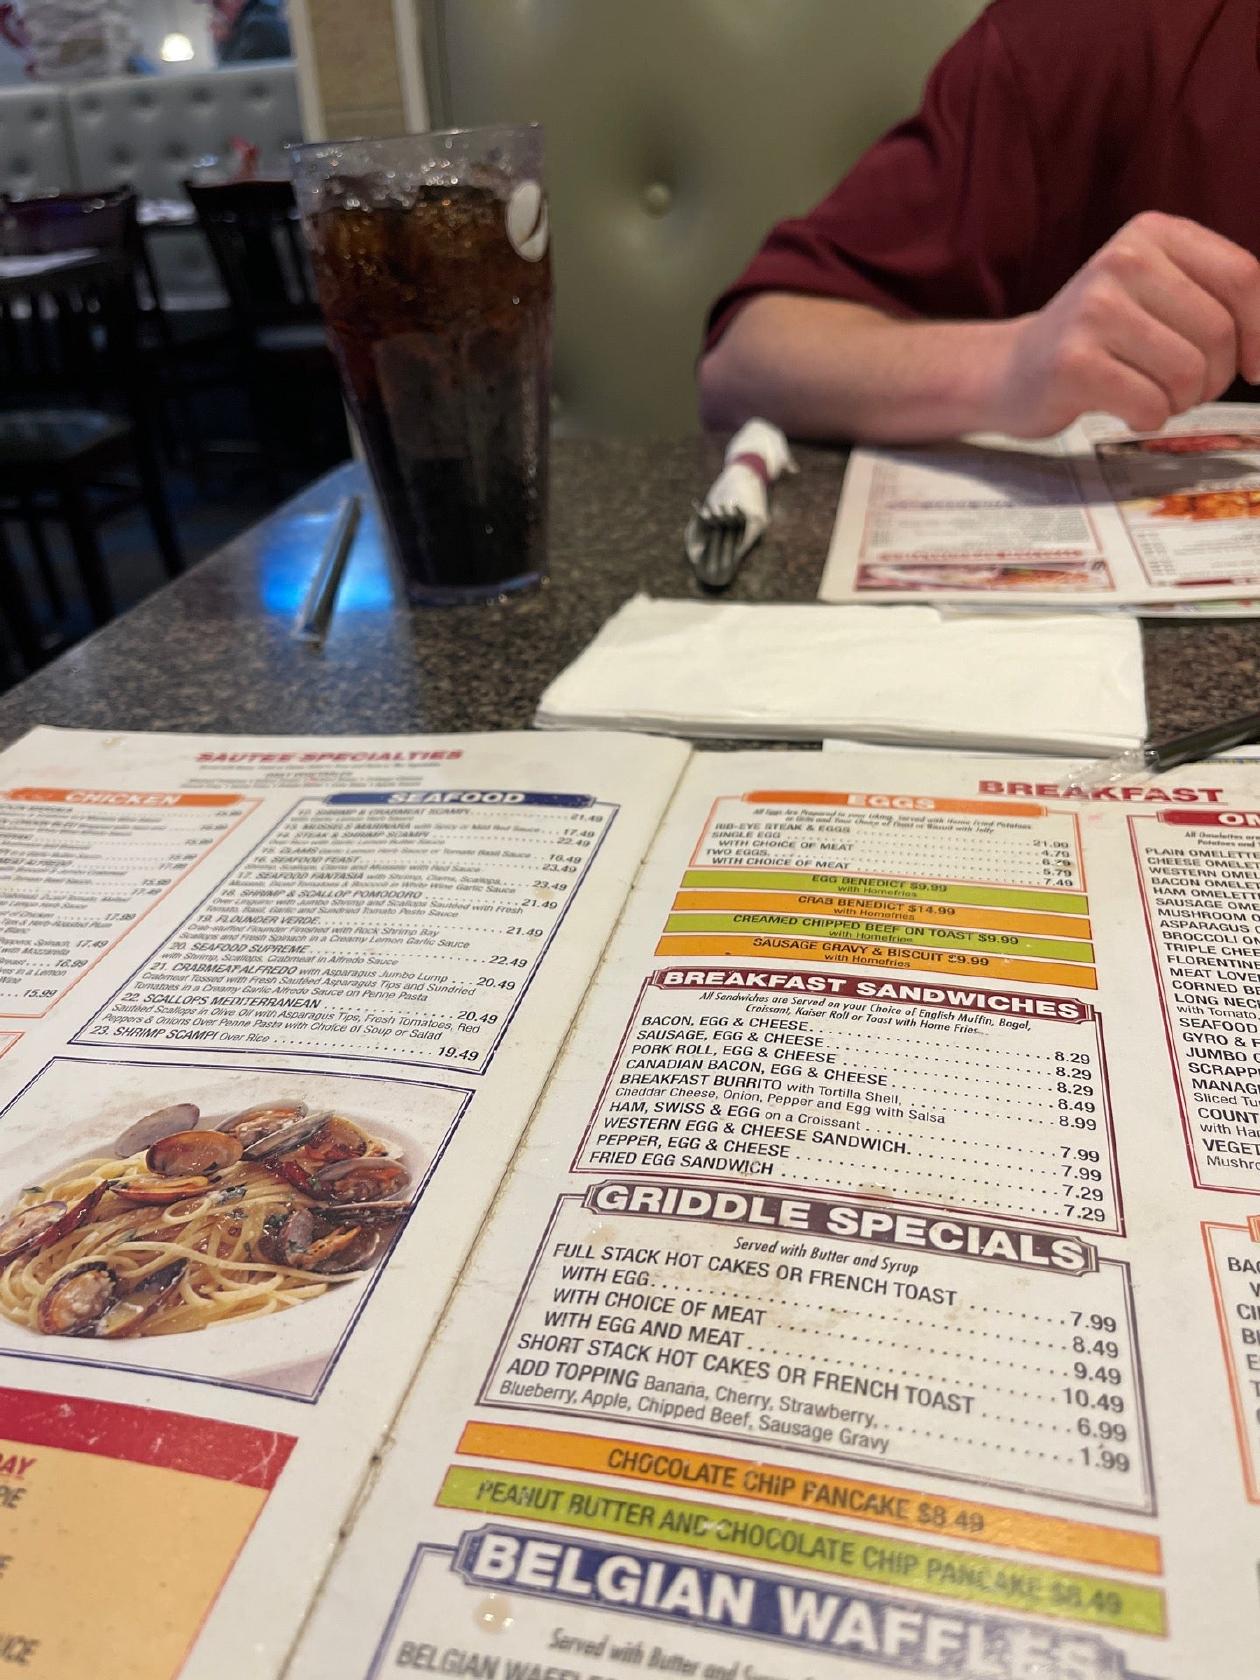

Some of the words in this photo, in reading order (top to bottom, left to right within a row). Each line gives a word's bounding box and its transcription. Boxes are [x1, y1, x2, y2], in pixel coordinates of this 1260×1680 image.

[299, 750, 464, 762] SPECIALTIES
[65, 793, 181, 805] CHICKEN
[388, 792, 525, 805] SEAFOOD
[978, 780, 1224, 802] BREAKFAST
[848, 794, 936, 811] EGGS
[746, 858, 792, 866] CHOICE
[816, 861, 850, 869] MEAT
[1044, 878, 1073, 887] 7.49
[1043, 869, 1072, 877] 5.79
[1149, 867, 1217, 878] WESTERN
[1151, 877, 1200, 887] BACON
[1153, 887, 1186, 896] HAM
[798, 895, 833, 905] CRAB
[838, 898, 906, 911] BENEDICT
[908, 905, 956, 915] $14.99
[1156, 898, 1224, 909] SAUSAGE
[1158, 908, 1247, 922] MUSHROOM
[506, 926, 544, 938] 21.49
[733, 914, 798, 925] CREAMED
[802, 918, 861, 930] CHIPPED
[865, 924, 900, 934] BEEF
[905, 926, 924, 936] ON
[930, 929, 974, 940] TOAST
[978, 934, 1019, 945] $9.99
[1160, 920, 1250, 933] ASPARAGUS
[1162, 931, 1238, 944] BROCCOLI
[1164, 942, 1217, 954] TRIPLE
[190, 942, 248, 952] SEAFOOD
[248, 944, 310, 953] SUPREME
[488, 955, 528, 968] 22.49
[752, 938, 818, 950] SAUSAGE
[822, 943, 868, 953] GRAVY
[872, 948, 882, 956] &
[888, 949, 943, 961] BISCUIT
[54, 959, 89, 968] 16.99
[824, 954, 849, 962] with
[852, 955, 911, 968] Homefries
[172, 963, 241, 974] CRABMEAT
[240, 965, 298, 975] ALFREDO
[476, 977, 516, 990] 20.49
[1169, 968, 1212, 979] MEAT
[23, 989, 57, 998] 15.99
[663, 971, 847, 993] BREAKFAST
[856, 980, 1080, 1019] SANDWICHES
[1172, 980, 1238, 994] CORNED
[143, 994, 208, 1005] SCALLOPS
[210, 997, 322, 1009] MEDITERRANEAN
[457, 1011, 499, 1025] 20.49
[1174, 993, 1219, 1006] LONG
[1179, 1018, 1258, 1034] SEAFOOD
[89, 1025, 110, 1035] 23.
[113, 1027, 166, 1038] SHRIMP
[165, 1029, 220, 1041] SCAMPI
[219, 1032, 245, 1042] Over
[245, 1034, 270, 1043] Rice
[438, 1046, 480, 1061] 19.49
[641, 1016, 695, 1027] BACON,
[699, 1016, 729, 1027] EGG
[732, 1018, 744, 1027] &
[749, 1018, 809, 1032] CHEESE
[1054, 1051, 1091, 1065] 8.29
[1182, 1032, 1229, 1046] GYRO
[1234, 1037, 1247, 1048] &
[1185, 1047, 1247, 1062] JUMBO
[631, 1044, 673, 1055] PORK
[676, 1045, 718, 1056] ROLL,
[722, 1046, 753, 1056] EGG
[757, 1047, 769, 1058] &
[774, 1049, 837, 1064] CHEESE
[1056, 1082, 1094, 1097] 8.29
[626, 1060, 704, 1070] CANADIAN
[708, 1060, 765, 1075] BACON,
[771, 1064, 802, 1076] EGG
[807, 1066, 819, 1078] &
[823, 1069, 888, 1087] CHEESE
[1058, 1099, 1096, 1113] 8.49
[620, 1074, 710, 1085] BREAKFAST
[713, 1074, 782, 1090] BURRITO
[787, 1083, 814, 1094] with
[819, 1085, 861, 1100] Tortilla
[865, 1091, 902, 1105] Shell,
[1059, 1115, 1097, 1131] 8.99
[1193, 1092, 1238, 1107] Sliced
[609, 1102, 649, 1114] HAM,
[654, 1102, 705, 1114] SWISS
[710, 1104, 722, 1115] &
[727, 1105, 760, 1118] EGG
[765, 1111, 781, 1120] on
[785, 1114, 793, 1122] a
[798, 1113, 861, 1131] Croissant
[1059, 1146, 1100, 1163] 7.99
[1199, 1123, 1232, 1135] with
[604, 1118, 681, 1130] WESTERN
[685, 1120, 718, 1132] EGG
[723, 1122, 735, 1134] &
[741, 1124, 808, 1142] CHEESE
[812, 1131, 906, 1154] SANDWICH
[1061, 1164, 1102, 1182] 7.99
[597, 1134, 662, 1148] PEPPER,
[668, 1137, 701, 1149] EGG
[705, 1139, 718, 1150] &
[723, 1140, 791, 1158] CHEESE
[1062, 1184, 1104, 1202] 7.29
[589, 1152, 637, 1165] FRIED
[641, 1154, 676, 1167] EGG
[680, 1155, 774, 1175] SANDWICH
[1063, 1204, 1105, 1223] 7.29
[596, 1185, 811, 1229] GRIDDLE
[827, 1207, 1086, 1271] SPECIALS
[734, 1236, 779, 1254] Served
[780, 1244, 807, 1258] with
[810, 1246, 849, 1265] Butter
[853, 1255, 879, 1269] and
[881, 1256, 919, 1276] Syrup
[553, 1243, 596, 1260] FULL
[601, 1245, 659, 1265] STACK
[665, 1252, 704, 1270] HOT
[708, 1256, 770, 1278] CAKES
[776, 1264, 803, 1282] OR
[808, 1269, 888, 1295] FRENCH
[893, 1282, 958, 1306] TOAST
[1069, 1310, 1117, 1334] 7.99
[561, 1266, 607, 1283] WITH
[612, 1270, 650, 1287] EGG
[1072, 1336, 1119, 1359] 8.49
[553, 1288, 599, 1306] WITH
[604, 1291, 675, 1314] CHOICE
[681, 1299, 707, 1317] OF
[711, 1301, 767, 1326] MEAT
[1073, 1362, 1122, 1385] 9.49
[517, 1333, 583, 1354] SHORT
[587, 1339, 651, 1362] STACK
[656, 1348, 699, 1370] HOT
[703, 1353, 771, 1379] CAKES
[777, 1365, 807, 1385] OR
[813, 1371, 899, 1401] FRENCH
[905, 1385, 975, 1415] TOAST
[1076, 1417, 1127, 1442] 6.99
[507, 1358, 549, 1378] ADD
[555, 1361, 640, 1389] TOPPING
[644, 1375, 708, 1400] Banana,
[716, 1385, 774, 1412] Cherry,
[779, 1396, 878, 1429] Strawberry,
[1080, 1447, 1130, 1473] 1.99
[607, 1448, 738, 1489] CHOCOLATE
[743, 1470, 796, 1496] CHIP
[802, 1481, 910, 1520] PANCAKE
[918, 1501, 985, 1532] $849
[472, 1532, 756, 1625] BELGIAN
[778, 1584, 1098, 1679] WAFFLES
